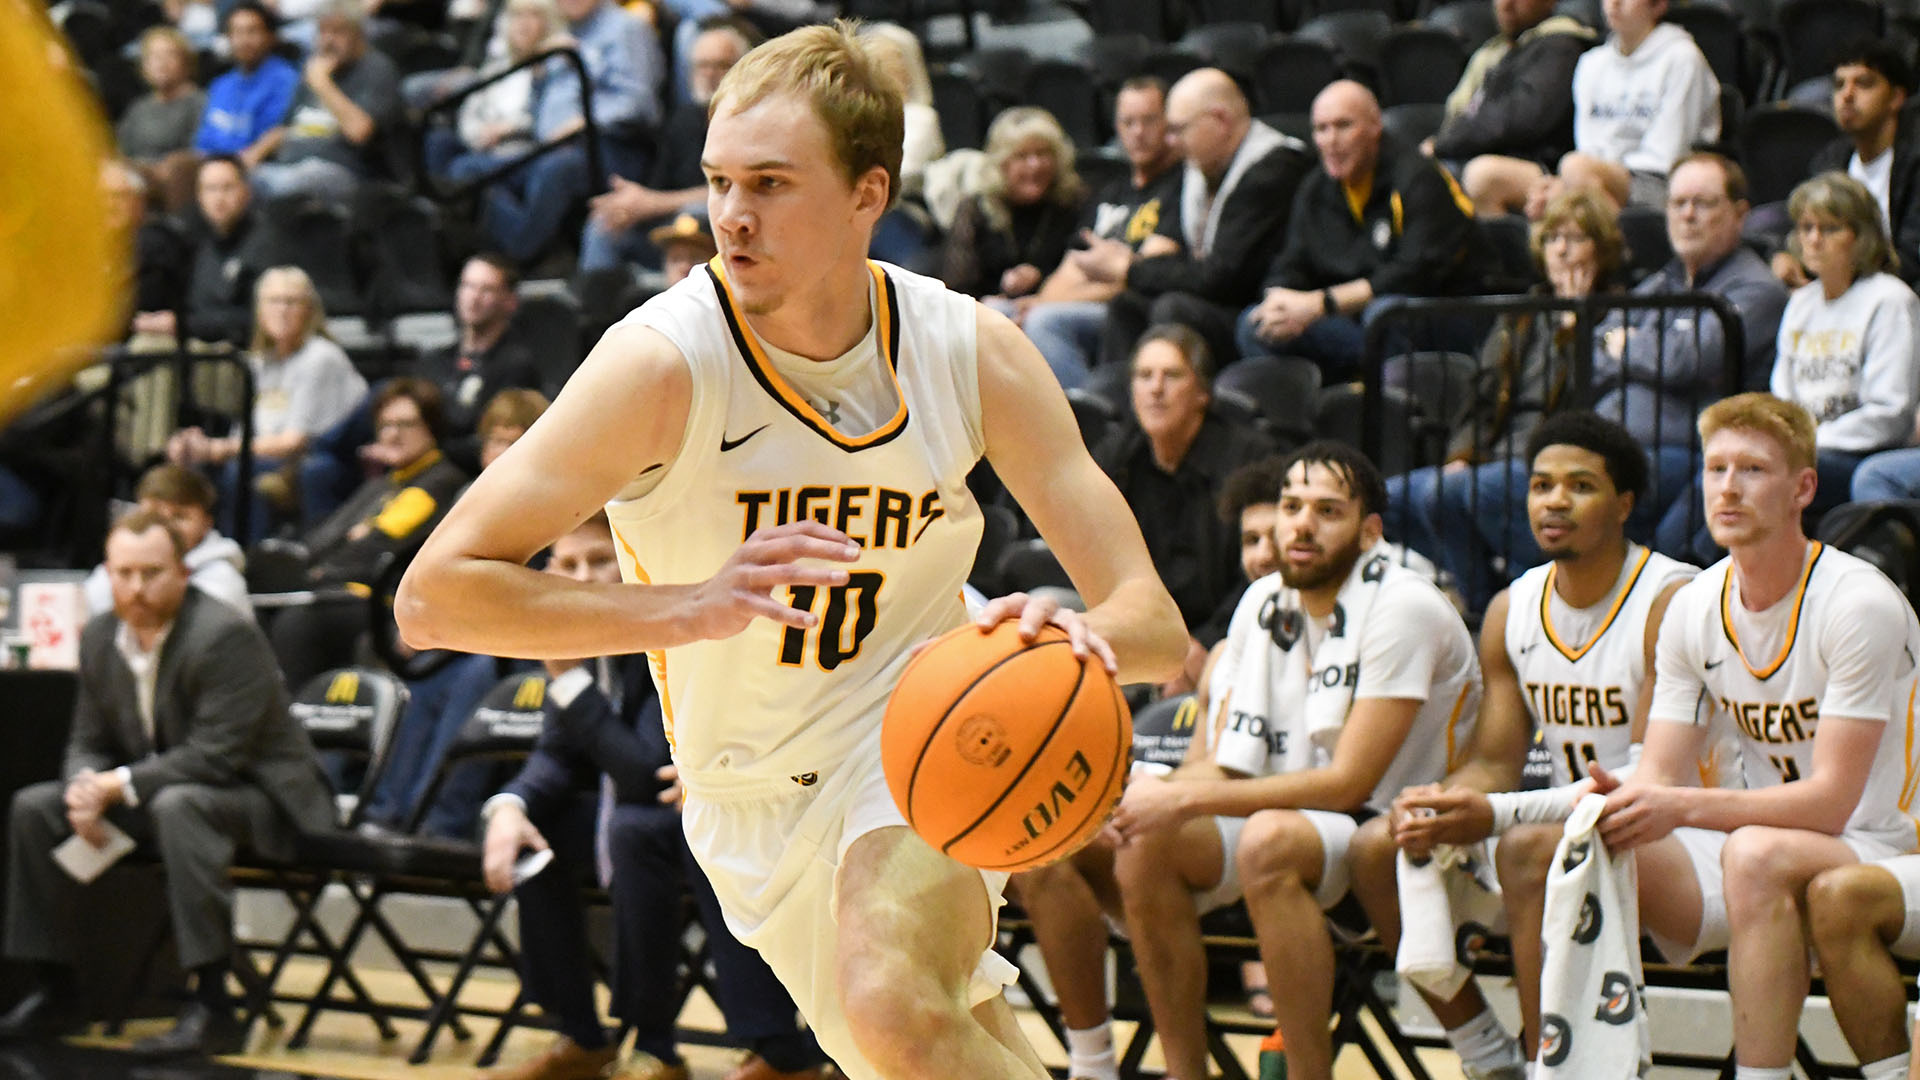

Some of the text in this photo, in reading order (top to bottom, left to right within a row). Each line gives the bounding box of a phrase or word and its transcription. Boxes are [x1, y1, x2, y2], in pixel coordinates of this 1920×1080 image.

[735, 484, 945, 550] TIGERS
[776, 568, 887, 673] 10
[1525, 682, 1629, 728] TIGERS
[1023, 749, 1092, 839] EVO
